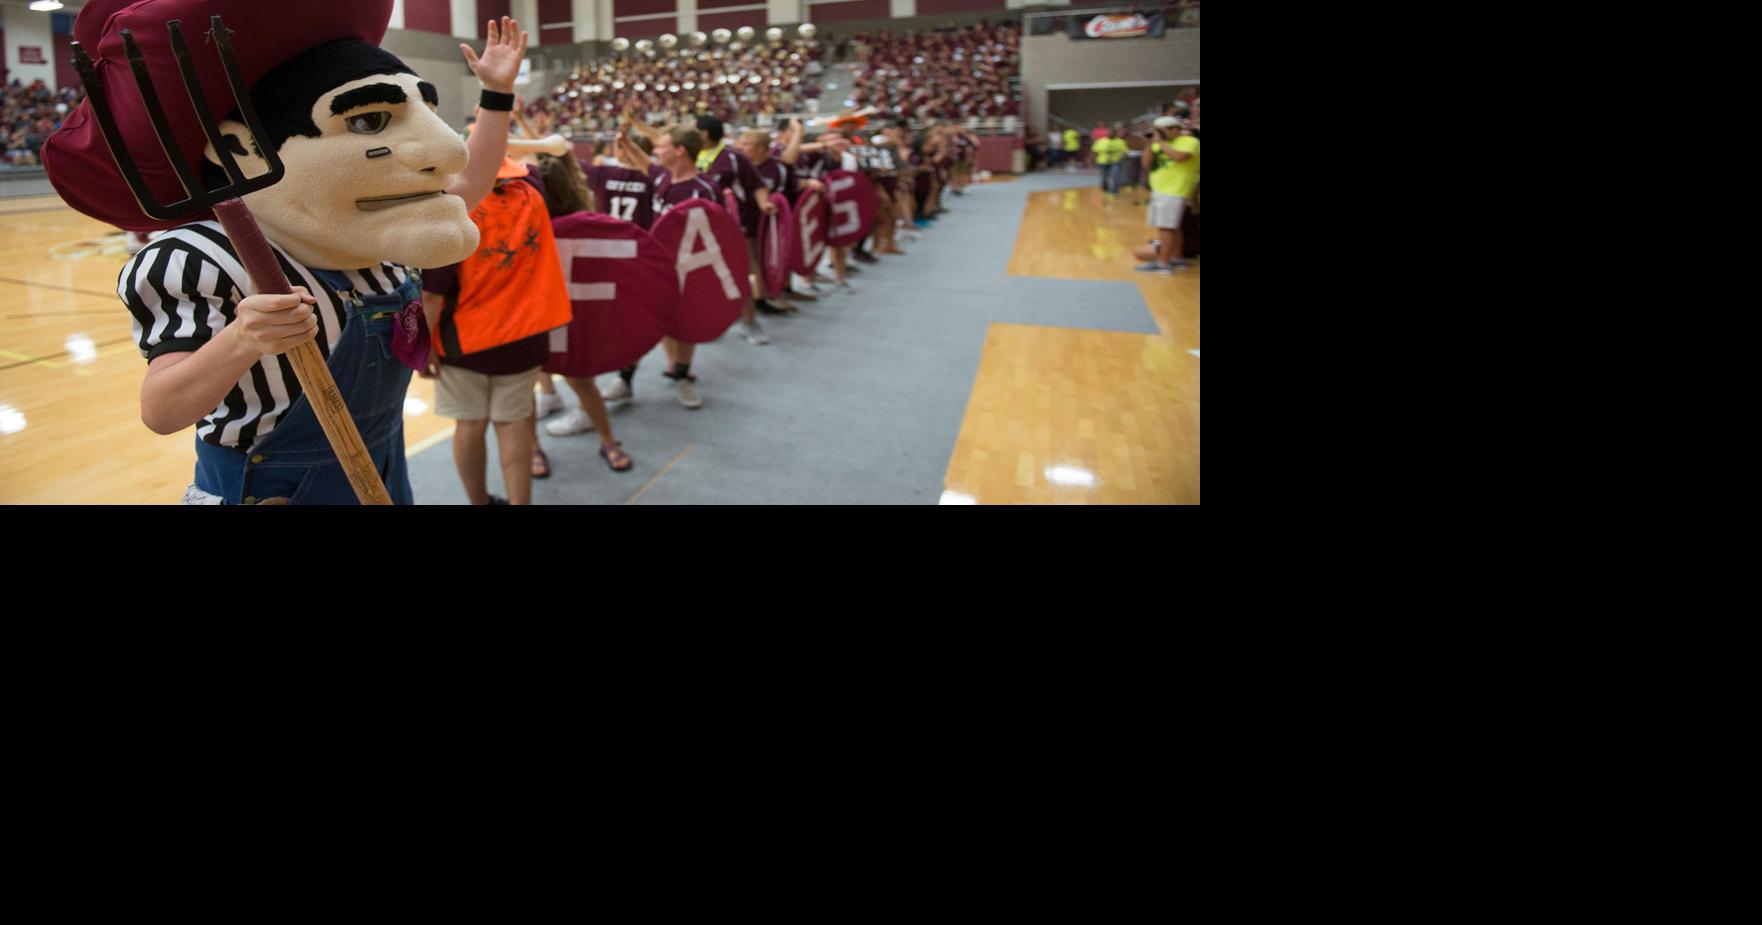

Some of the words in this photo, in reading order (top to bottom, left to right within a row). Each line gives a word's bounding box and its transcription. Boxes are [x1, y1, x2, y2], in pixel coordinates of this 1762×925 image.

[610, 196, 638, 221] 17
[549, 238, 637, 352] F
[675, 207, 741, 300] A
[800, 192, 824, 268] E
[828, 177, 861, 237] S
